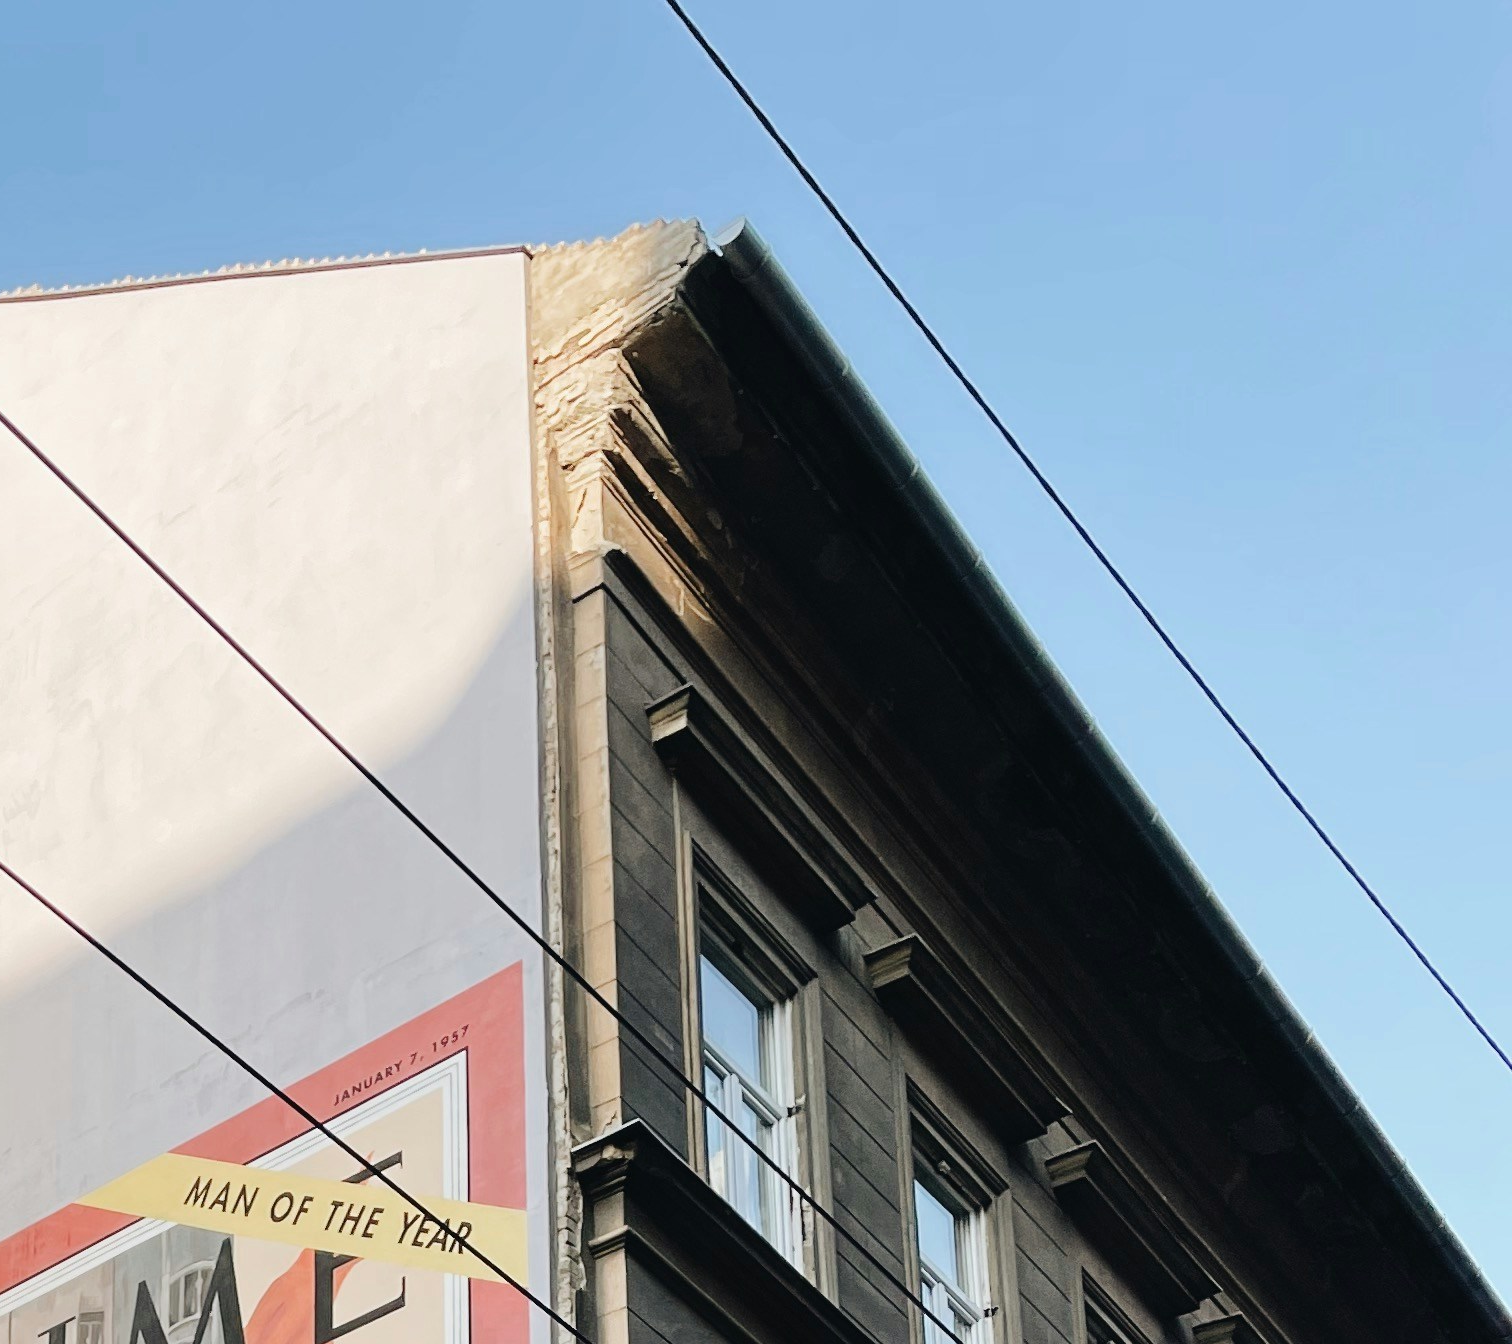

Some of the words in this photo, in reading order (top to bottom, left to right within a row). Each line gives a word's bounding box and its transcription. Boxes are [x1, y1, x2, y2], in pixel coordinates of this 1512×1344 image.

[333, 1060, 402, 1106] JANUARY
[410, 1051, 424, 1065] 7,
[432, 1023, 469, 1052] 1957
[183, 1175, 259, 1217] MAN
[270, 1191, 314, 1226] OF
[324, 1200, 384, 1239] THE
[397, 1211, 473, 1255] YEAR
